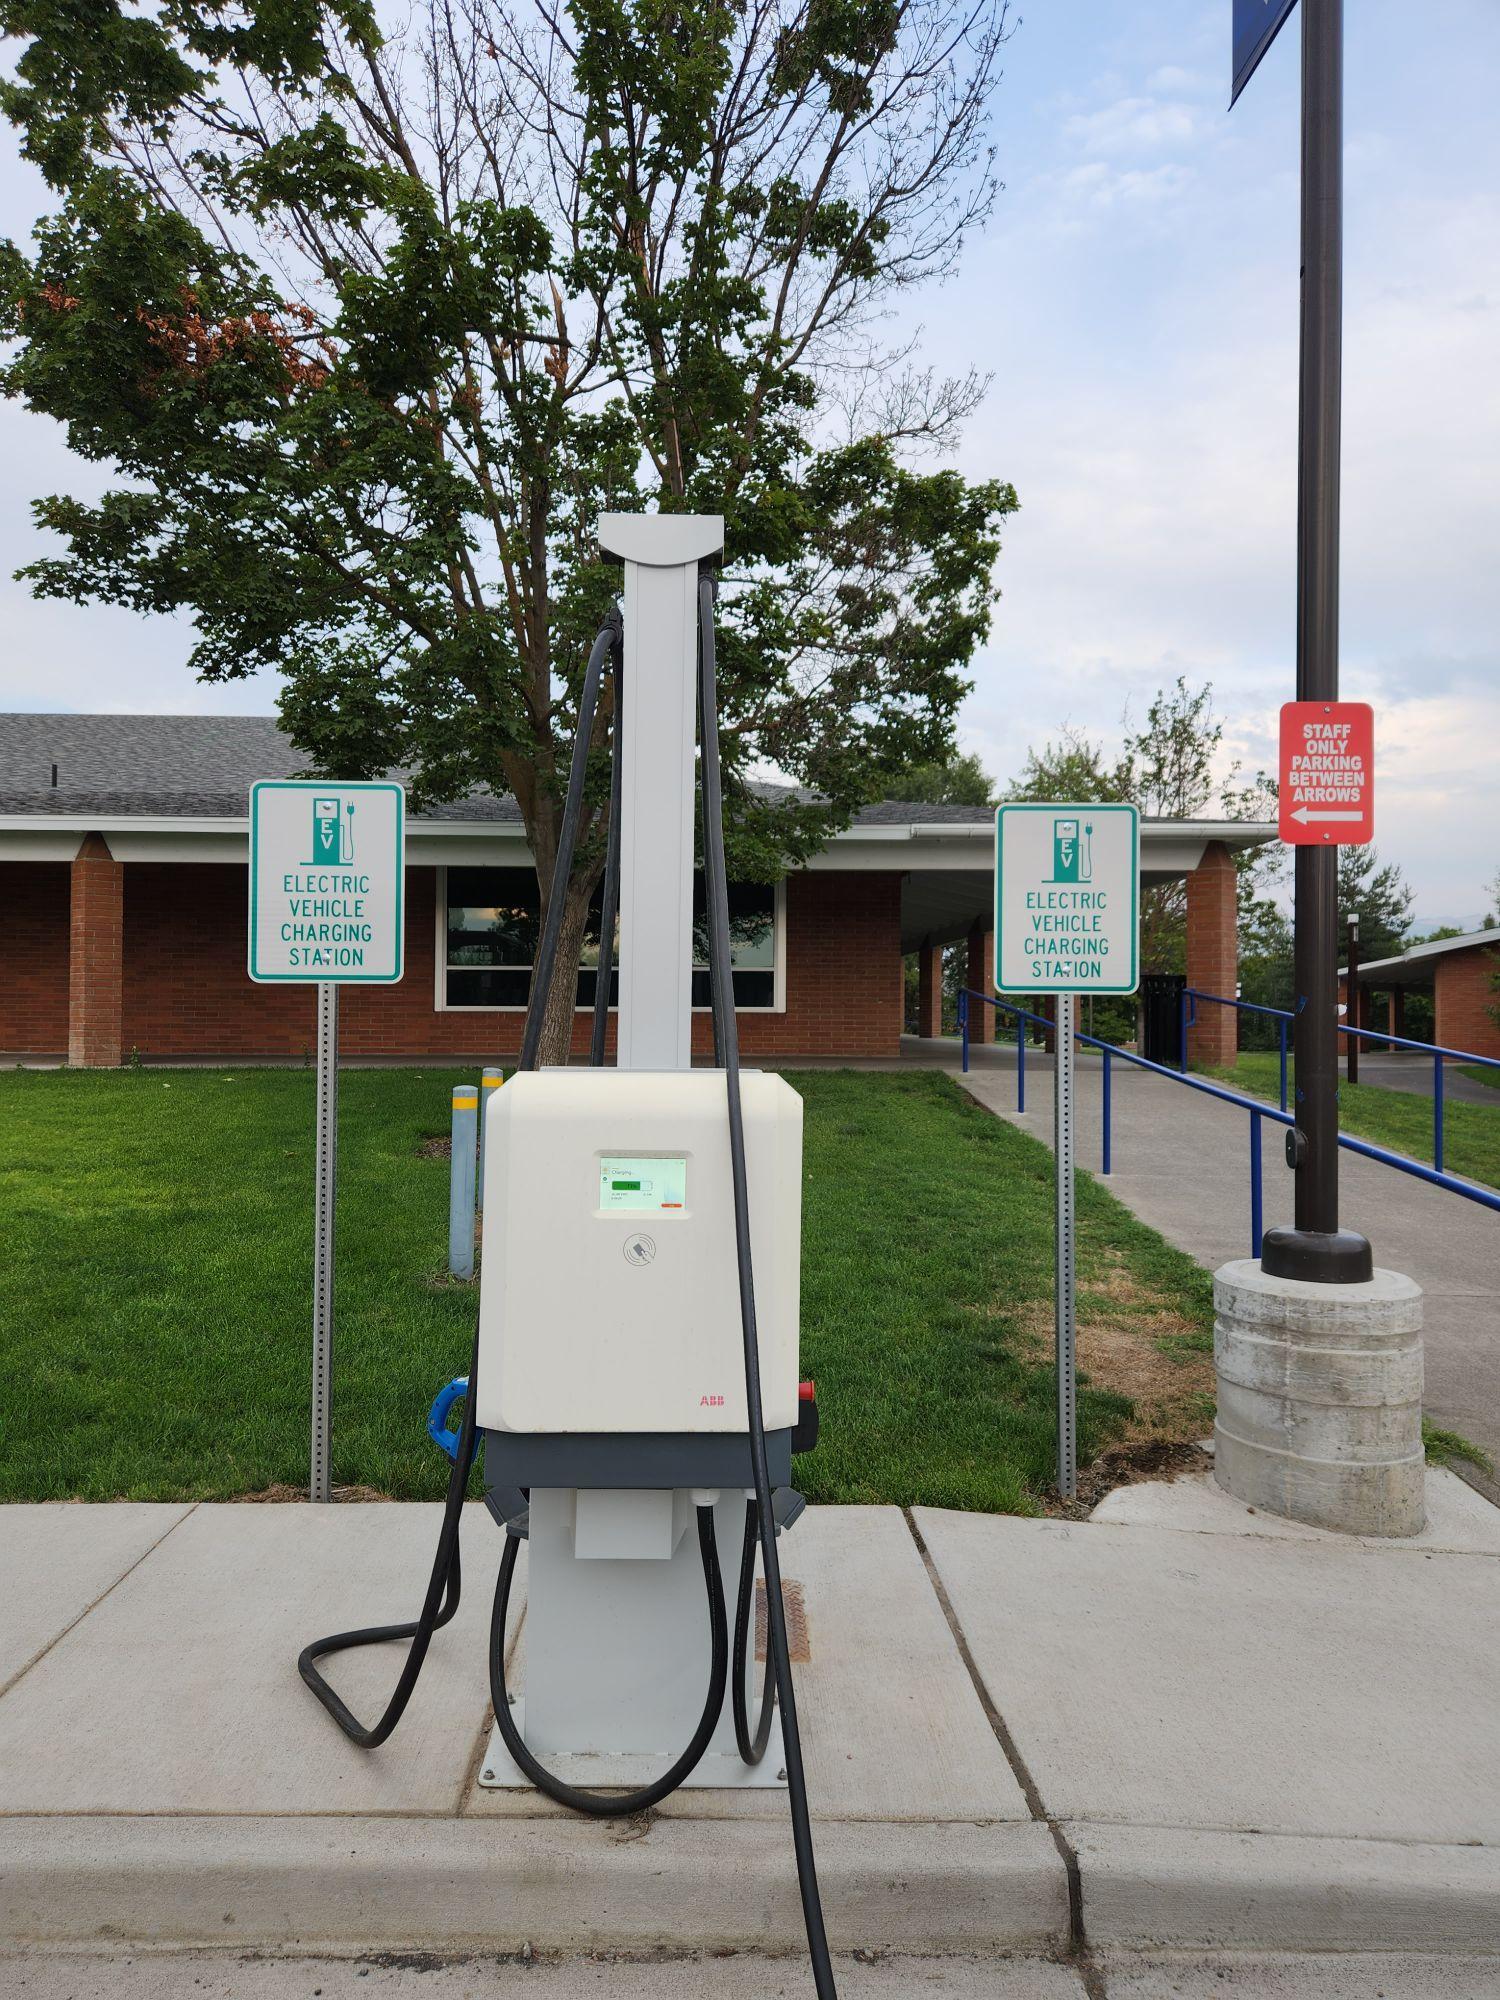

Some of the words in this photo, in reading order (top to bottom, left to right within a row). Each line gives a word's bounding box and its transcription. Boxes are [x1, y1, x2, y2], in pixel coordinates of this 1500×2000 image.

[1303, 723, 1352, 739] STAFF
[1306, 740, 1348, 755] ONLY
[1292, 755, 1363, 771] PARKING
[1289, 771, 1365, 787] BETWEEN
[1292, 787, 1361, 803] ARROWS
[283, 875, 370, 894] ELECTRIC
[289, 899, 365, 918] VEHICLE
[1026, 892, 1107, 910] ELECTRIC
[1032, 915, 1102, 932] VEHICLE
[281, 923, 372, 942] CHARGING
[1024, 938, 1109, 956] CHARGING
[289, 948, 364, 967] STATION
[1032, 961, 1101, 978] STATION
[700, 1395, 725, 1406] ABB
